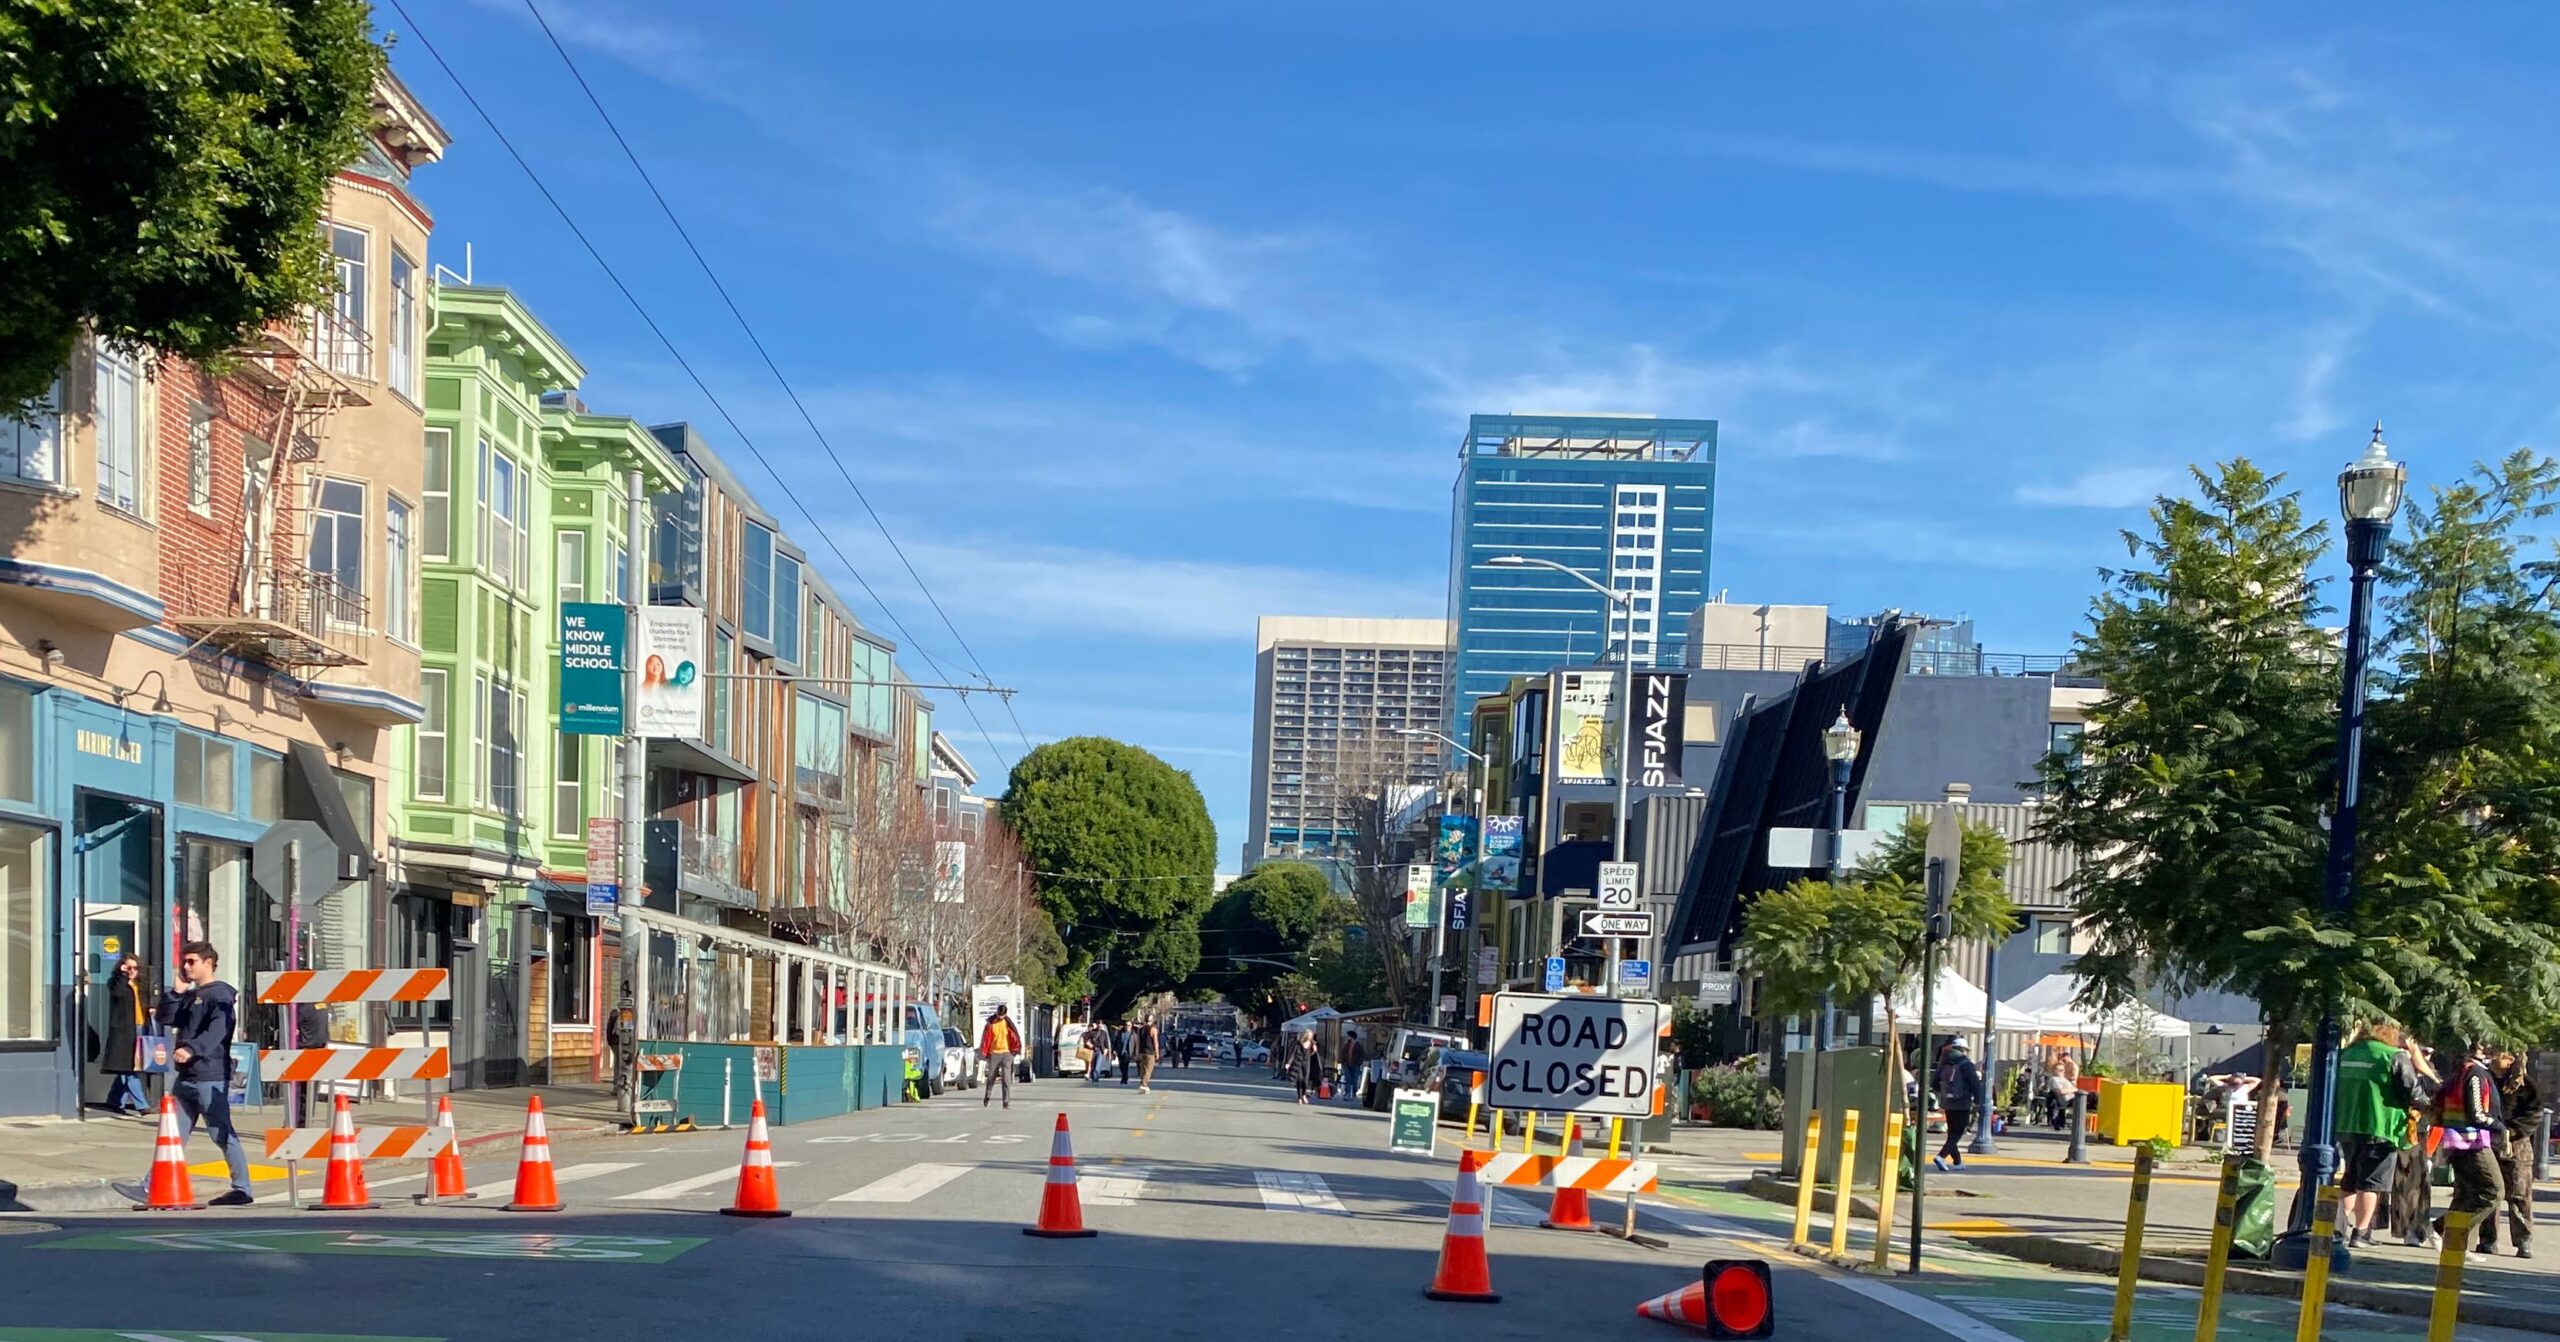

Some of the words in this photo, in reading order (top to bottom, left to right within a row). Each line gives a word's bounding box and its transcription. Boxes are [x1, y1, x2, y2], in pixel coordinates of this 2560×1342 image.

[565, 616, 586, 628] WE
[565, 630, 605, 642] KNOW
[565, 644, 612, 656] MIDDLE
[565, 658, 619, 669] SCHOOL.
[578, 703, 619, 713] millennium
[655, 706, 697, 716] millennium
[1643, 675, 1671, 788] SFJAZZ
[78, 729, 112, 758] MARINE
[1603, 868, 1635, 876] SPEED
[1603, 888, 1632, 904] 20
[1601, 919, 1621, 929] ONE
[1625, 920, 1646, 931] WAY
[1702, 982, 1731, 992] PROXY
[1520, 1013, 1628, 1050] ROAD
[1495, 1058, 1648, 1098] CLOSED
